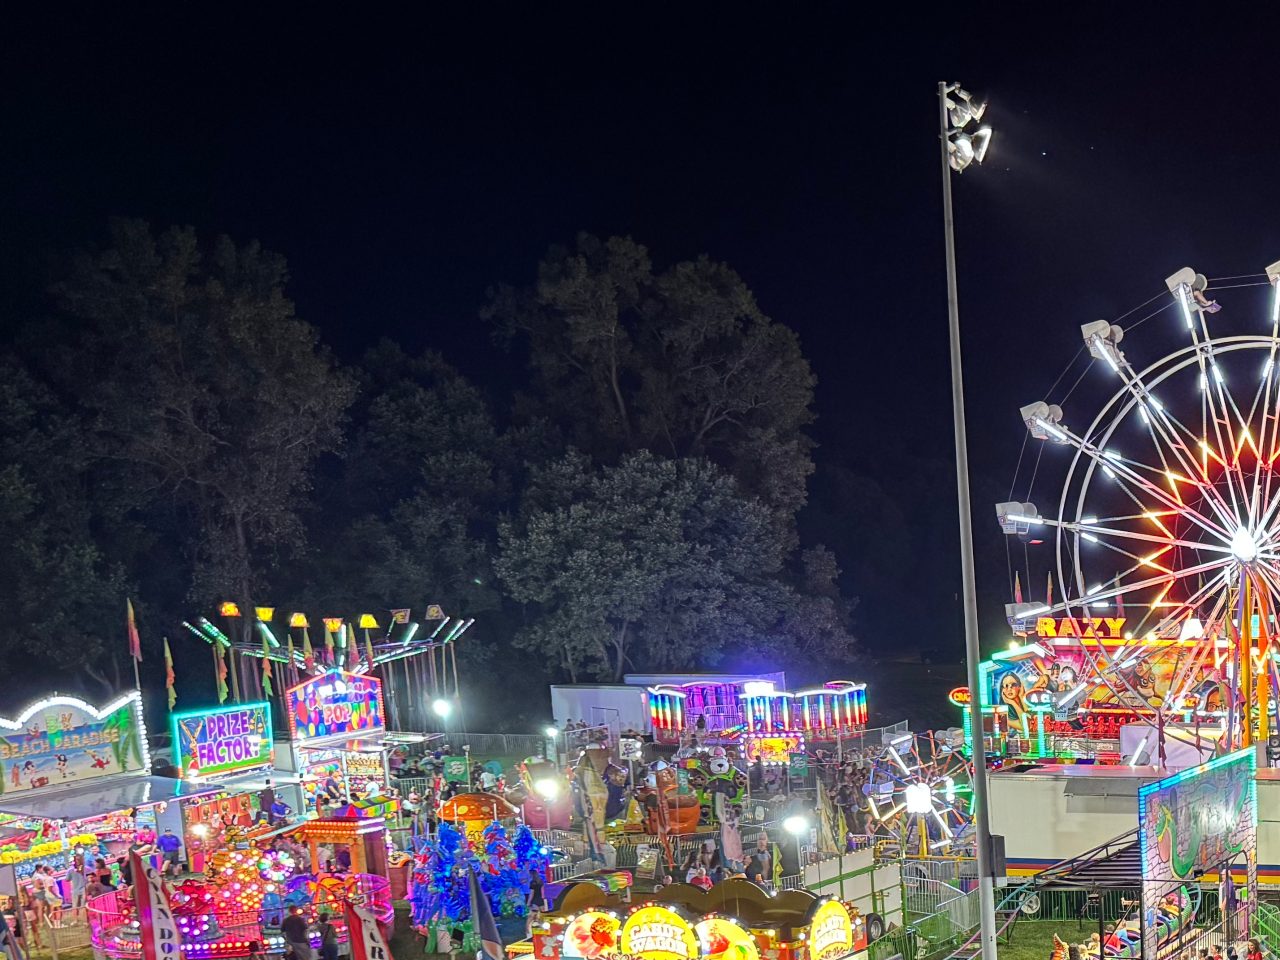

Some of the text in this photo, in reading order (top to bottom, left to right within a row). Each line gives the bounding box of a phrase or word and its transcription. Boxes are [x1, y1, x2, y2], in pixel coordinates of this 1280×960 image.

[1036, 617, 1127, 638] RAZY
[206, 711, 249, 739] PRIZE
[323, 703, 352, 725] POP
[0, 729, 119, 760] BEACH PARADISE
[197, 734, 262, 769] FACTORY
[629, 922, 685, 941] CANDY
